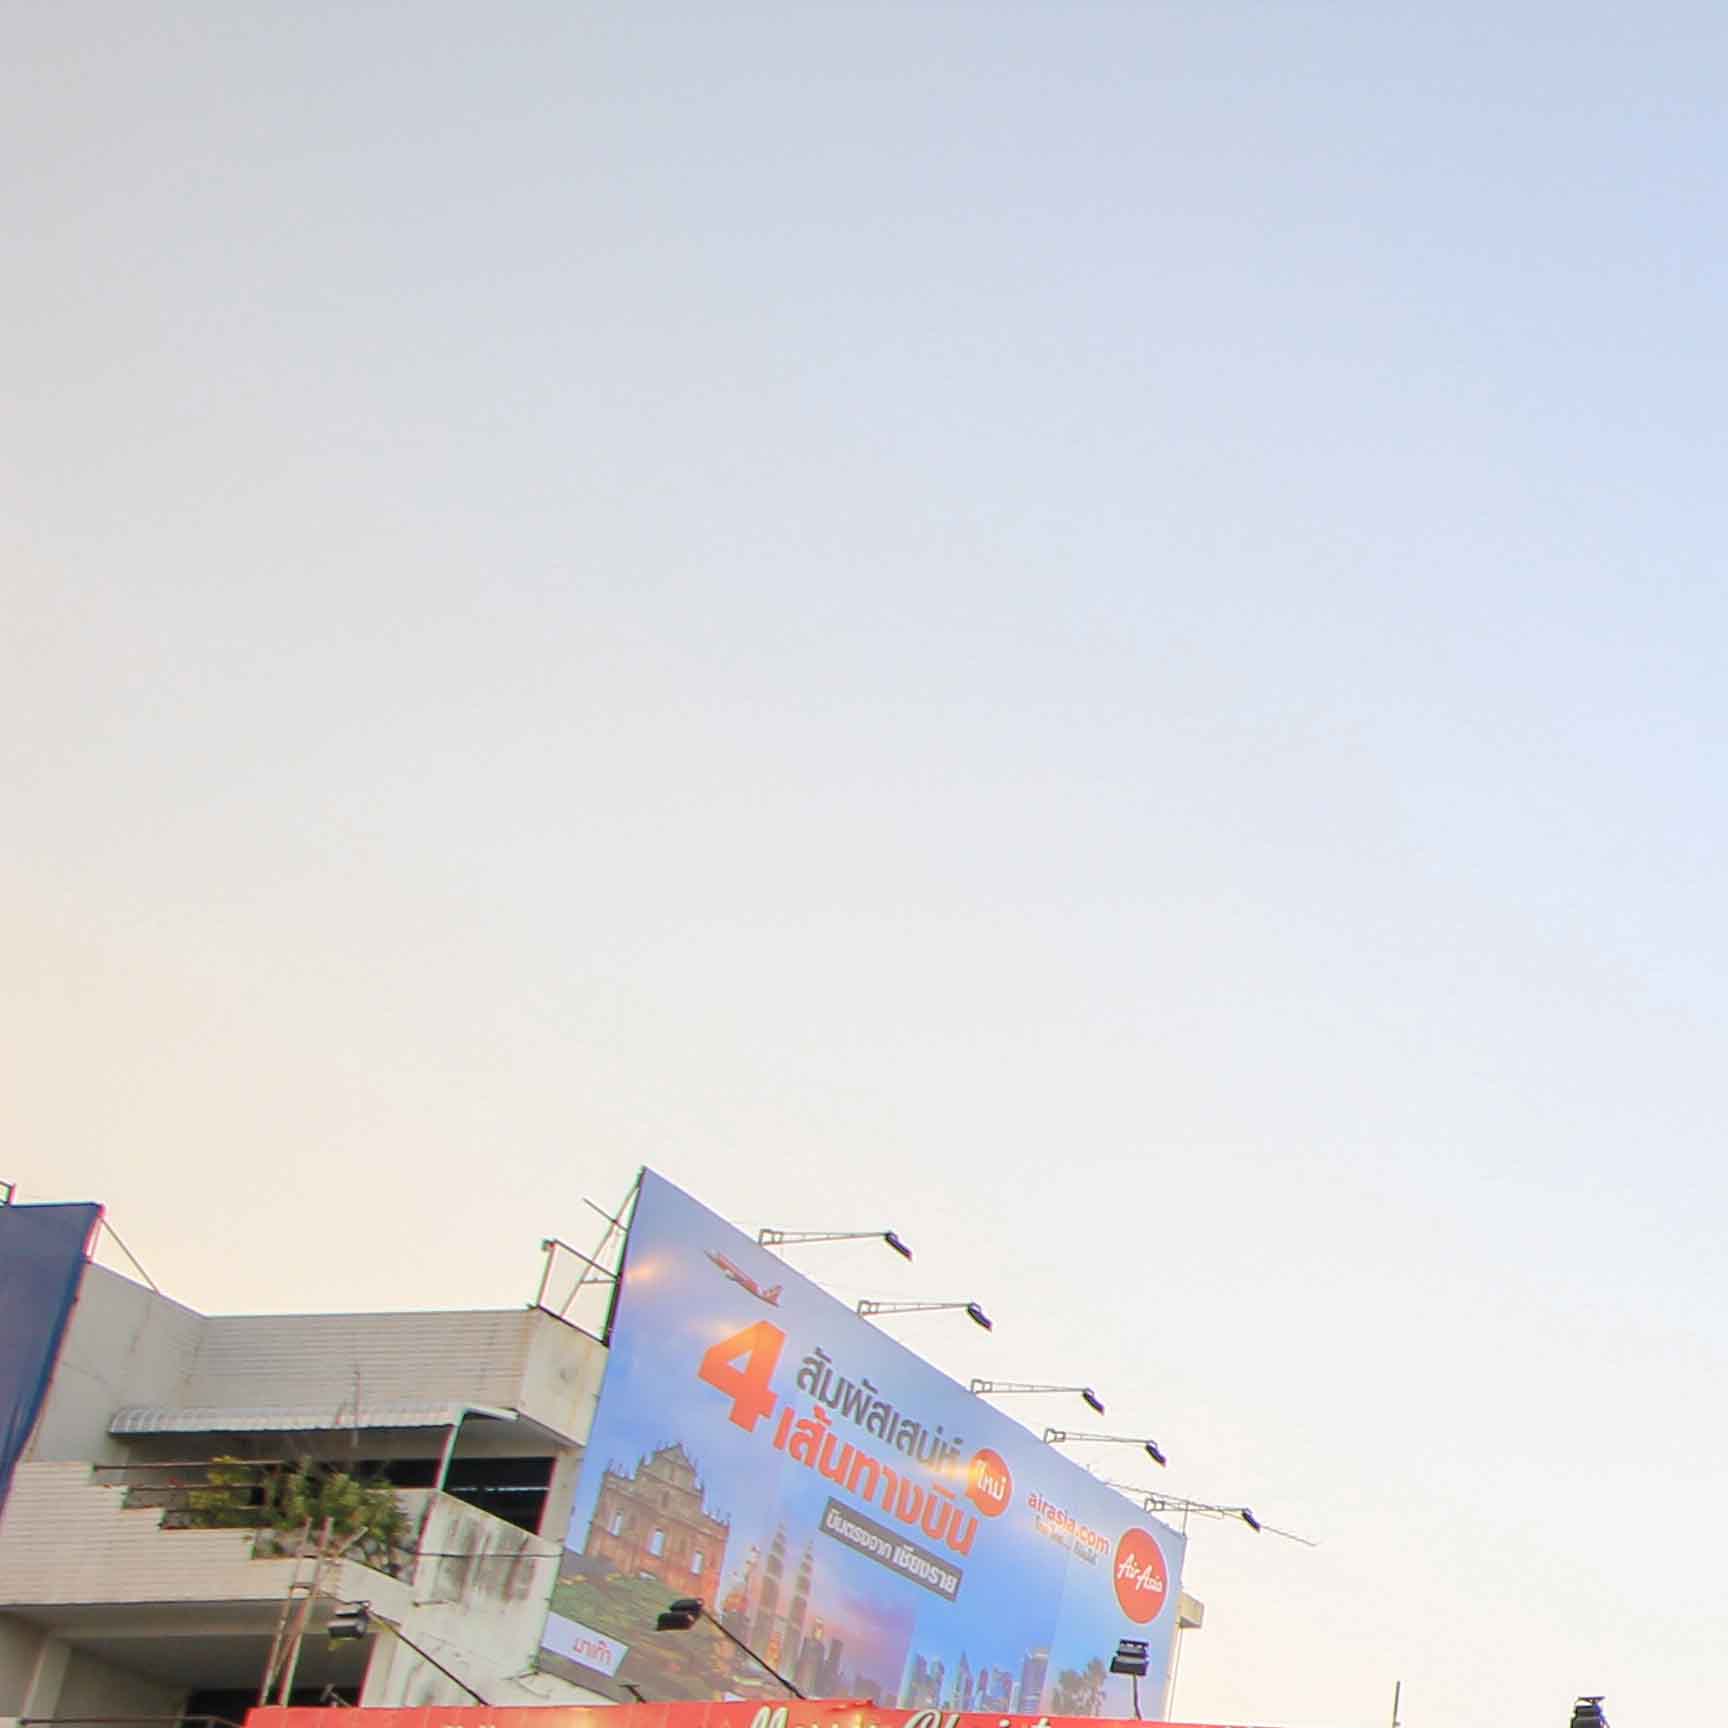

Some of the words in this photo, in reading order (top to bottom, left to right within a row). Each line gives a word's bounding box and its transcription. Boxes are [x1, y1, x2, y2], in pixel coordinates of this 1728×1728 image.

[699, 1320, 786, 1432] 4
[773, 1405, 978, 1557] เส้นทางบิน
[1027, 1490, 1109, 1555] airasia.com
[893, 1544, 957, 1593] เชียงราย
